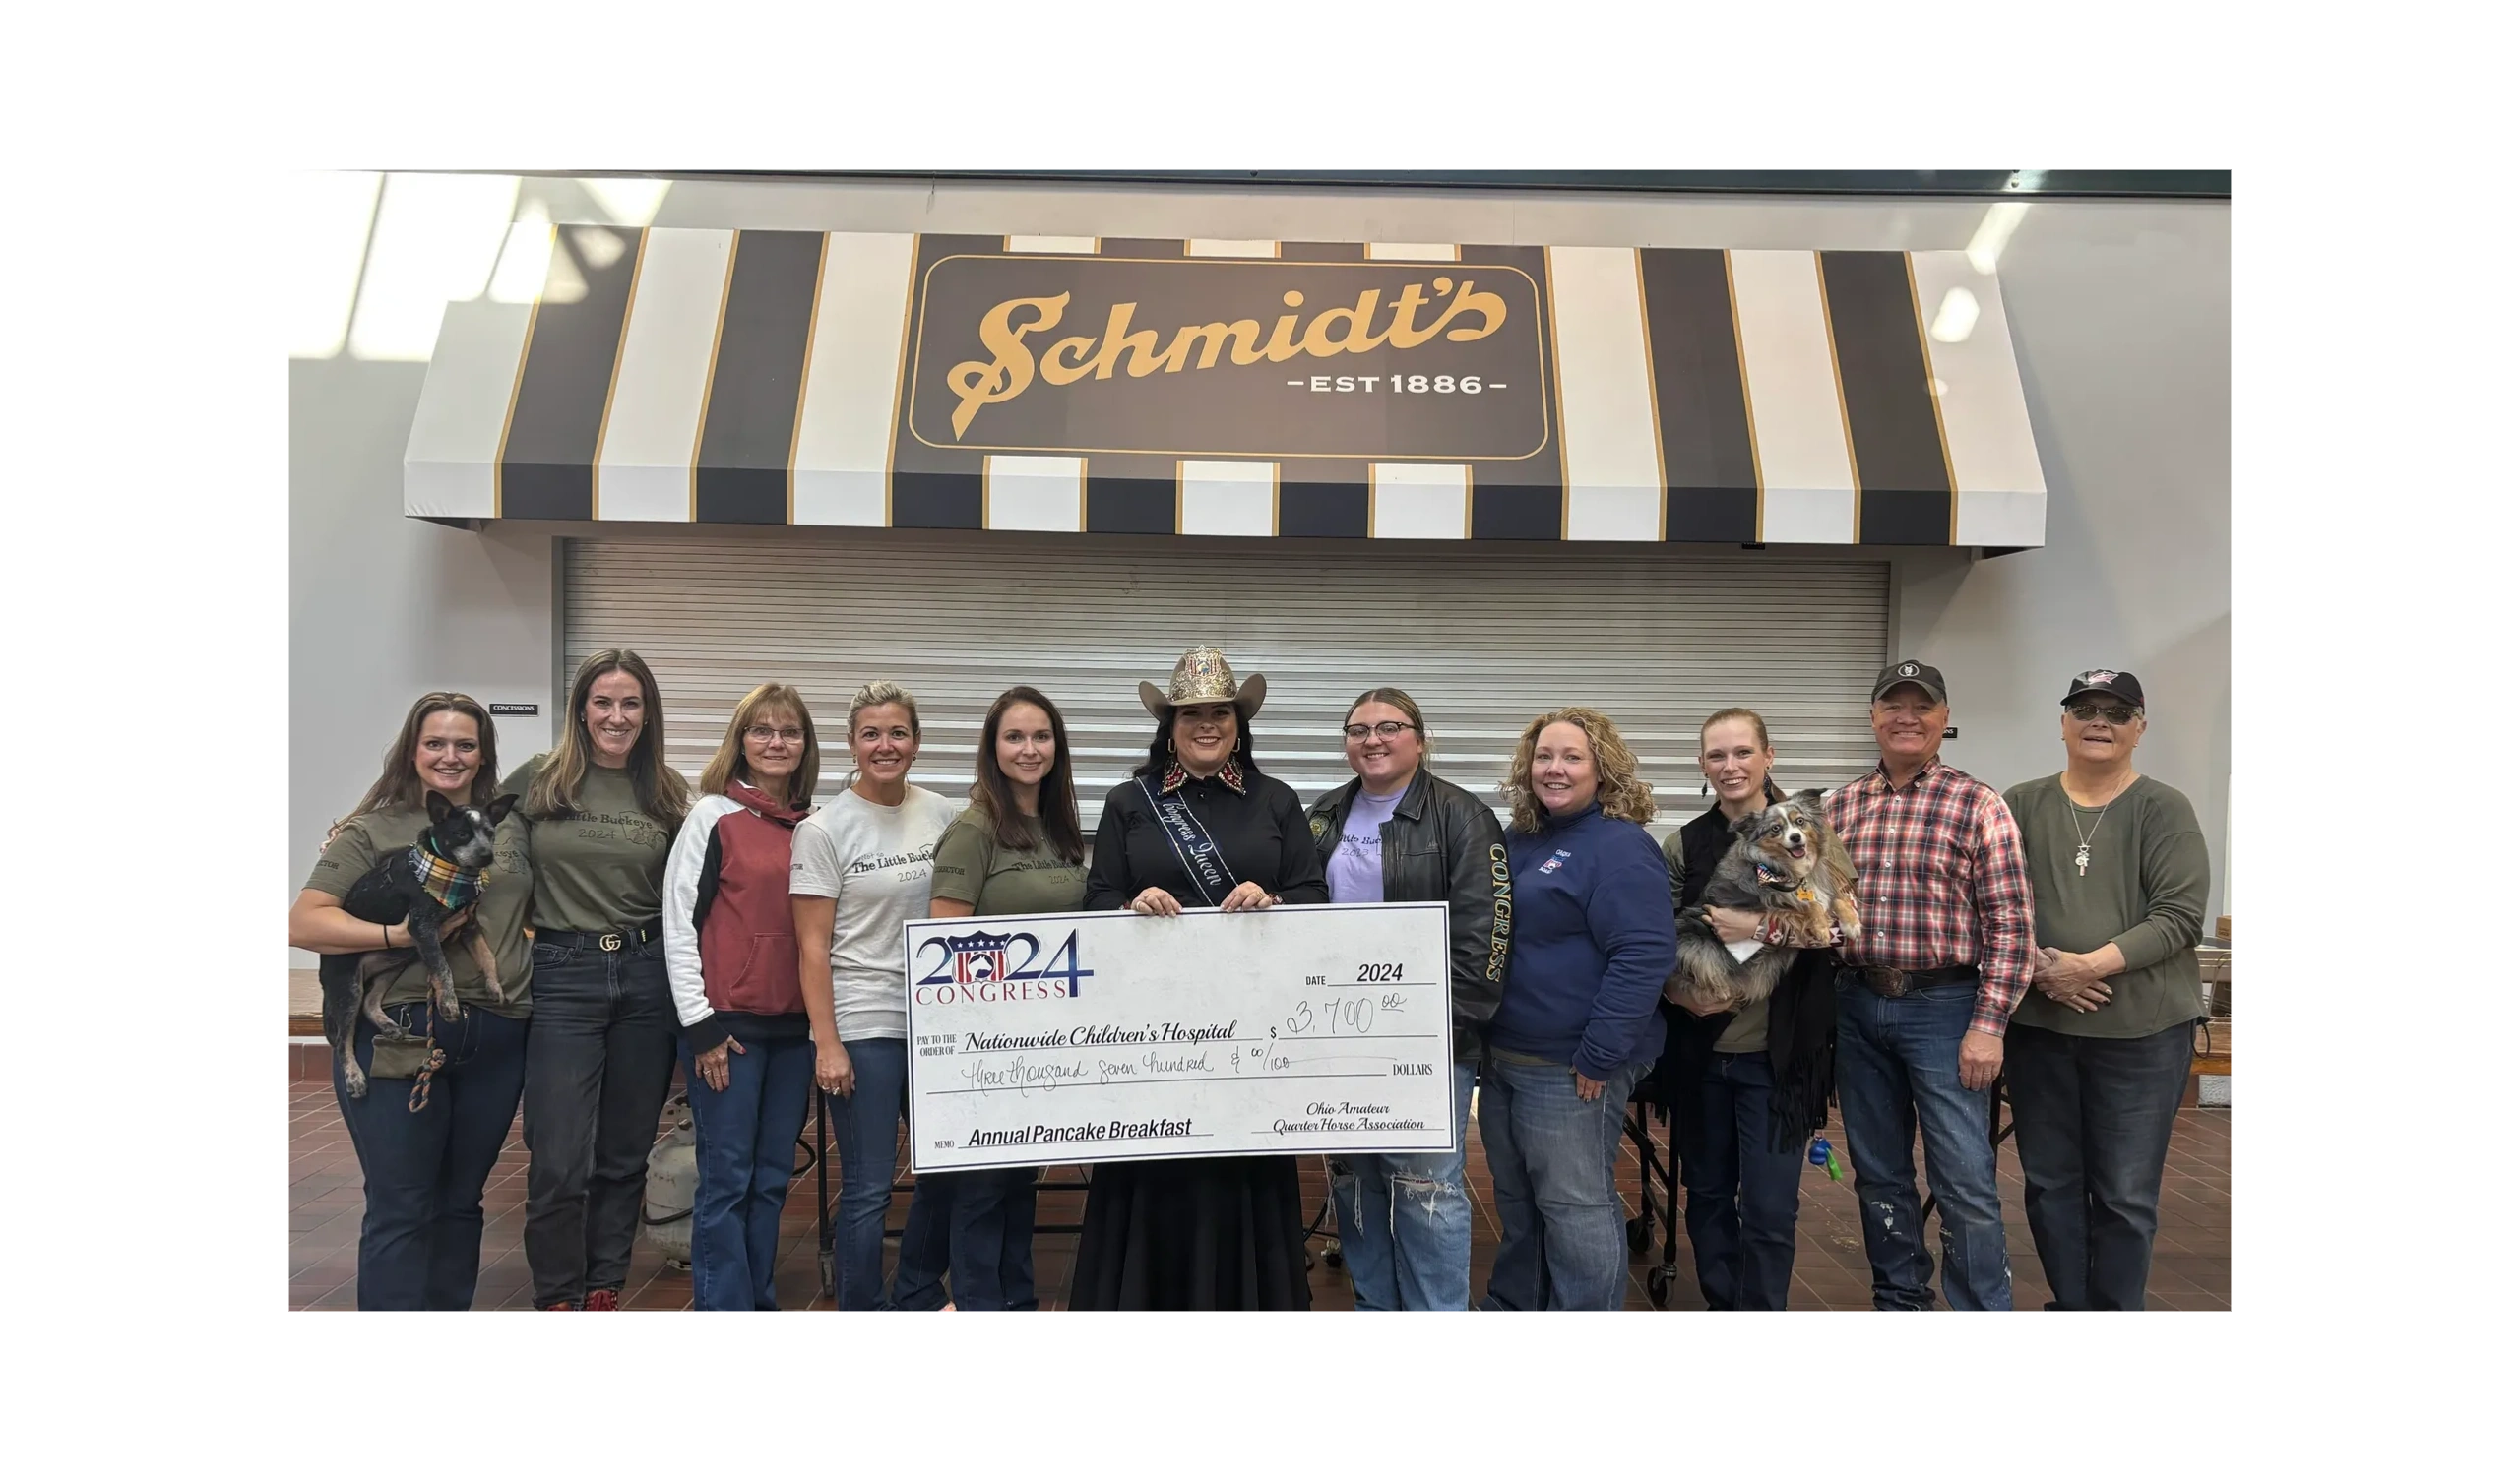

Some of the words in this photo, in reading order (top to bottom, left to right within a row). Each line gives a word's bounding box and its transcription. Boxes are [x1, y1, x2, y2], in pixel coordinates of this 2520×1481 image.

[947, 277, 1507, 442] Schmidt's
[600, 814, 653, 829] Buckeye
[578, 829, 616, 839] 2024
[1162, 802, 1196, 842] Congress
[1187, 842, 1222, 886] Queen
[852, 860, 876, 874] The
[877, 854, 908, 869] Little
[1012, 861, 1033, 871] The
[1032, 859, 1052, 871] Little
[897, 868, 927, 883] 2024
[1485, 843, 1512, 983] CONGRESS
[1356, 963, 1404, 982] 2024
[1305, 975, 1326, 986] DATE
[915, 980, 1066, 1006] CONGRESS
[916, 1036, 929, 1046] PAY
[930, 1035, 941, 1045] TO
[943, 1033, 957, 1044] THE
[965, 1028, 1068, 1052] Nationwide
[1069, 1023, 1157, 1045] Children's
[1160, 1019, 1238, 1045] Hospital
[1270, 1026, 1277, 1040] $
[919, 1047, 944, 1057] ORDER
[945, 1046, 955, 1056] OF
[1392, 1063, 1433, 1076] DOLLARS
[1306, 1101, 1337, 1115] Ohio
[1337, 1101, 1390, 1115] Amateur
[968, 1125, 1031, 1146] Annual
[1033, 1122, 1106, 1142] Pancake
[1108, 1118, 1192, 1139] Breakfast
[1273, 1118, 1320, 1135] Quarter
[1319, 1118, 1355, 1130] Horse
[1356, 1117, 1425, 1131] Association
[934, 1140, 955, 1149] MEMO
